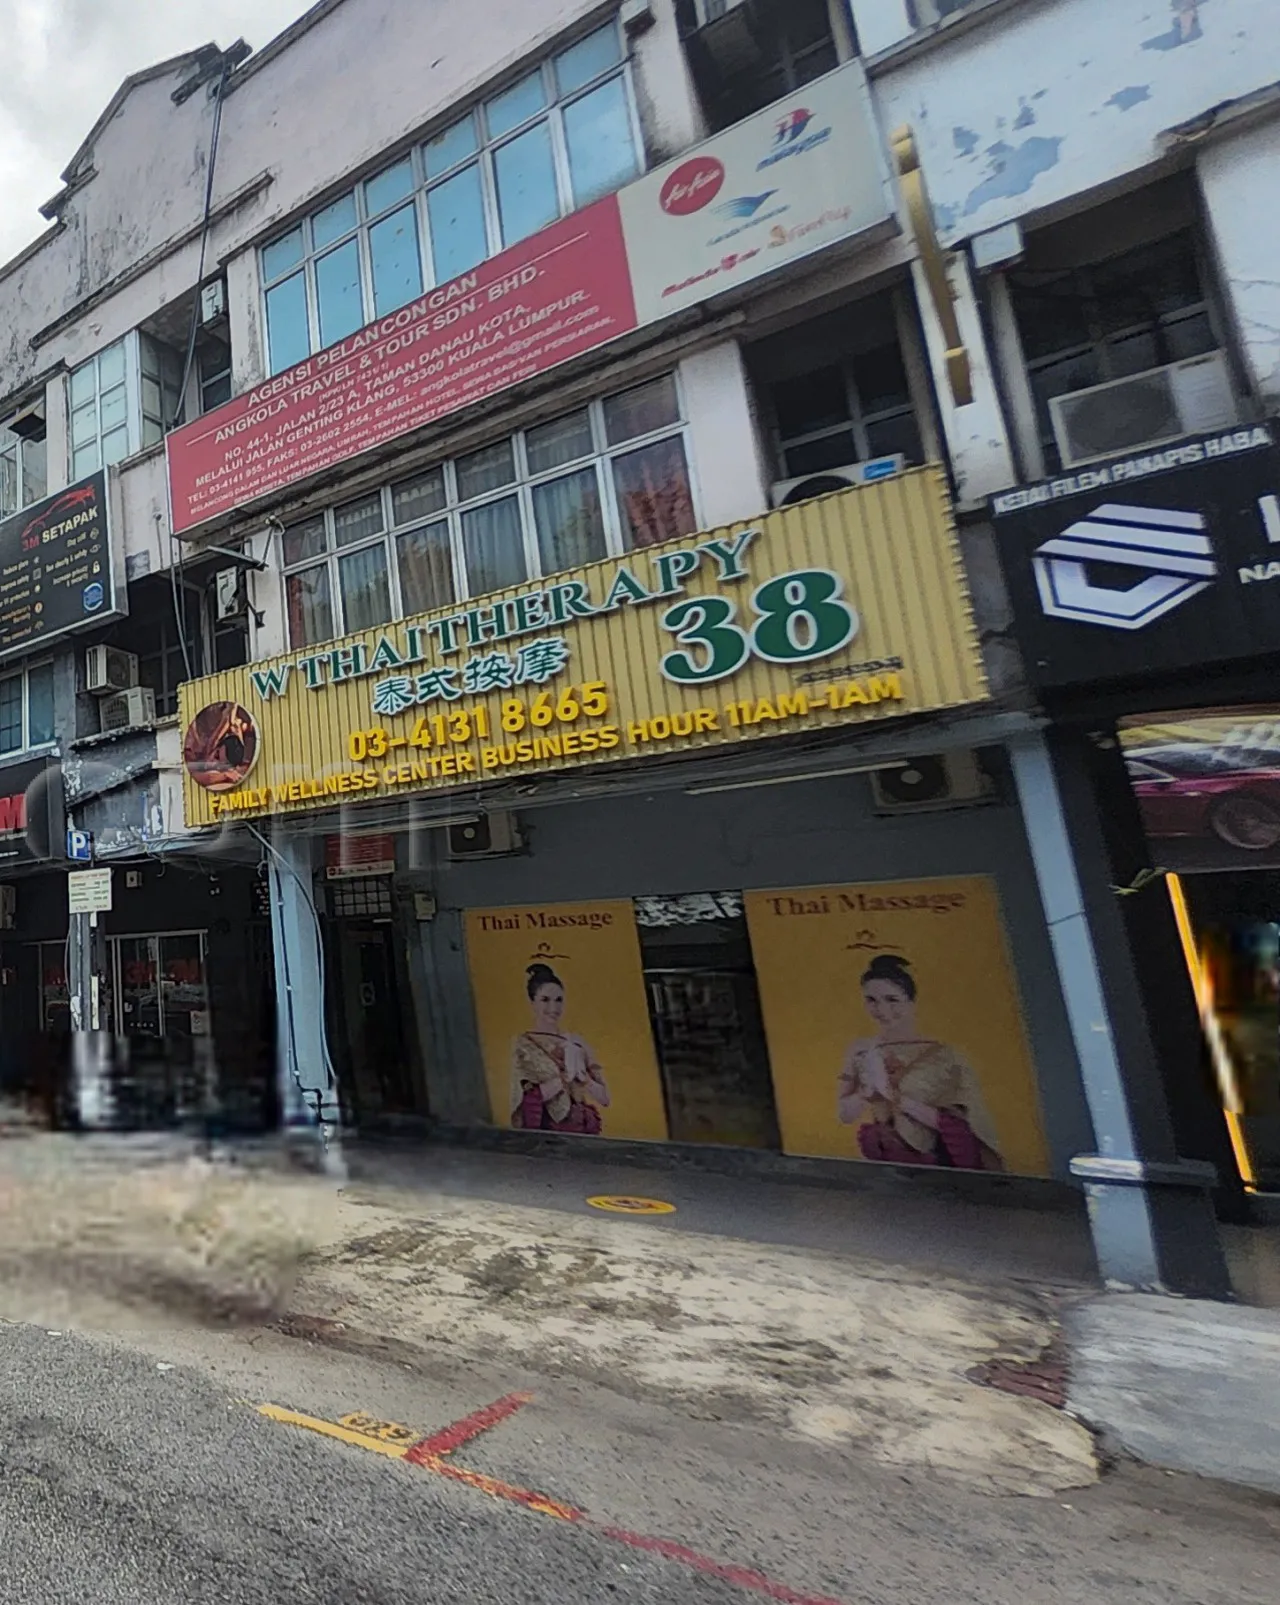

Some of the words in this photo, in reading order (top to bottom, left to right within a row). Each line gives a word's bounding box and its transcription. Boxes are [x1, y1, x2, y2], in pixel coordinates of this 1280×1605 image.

[214, 395, 287, 444] ANGKOLA
[291, 360, 355, 404] TRAVEL
[358, 352, 372, 370] &
[374, 321, 429, 361] TOUR
[432, 293, 483, 331] SDN.
[486, 260, 545, 302] BHD.
[247, 361, 311, 407] AGENSI
[316, 271, 477, 370] PELANCONGAN
[195, 456, 243, 488] MELALUI
[245, 437, 283, 464] JALAN
[286, 407, 343, 444] GENTING
[403, 359, 444, 388] 53300
[447, 328, 504, 365] KUALA
[224, 444, 244, 461] NO.
[275, 408, 315, 436] JALAN
[318, 394, 343, 414] 2/23
[365, 358, 415, 392] TAMAN
[418, 328, 474, 365] DANAU
[42, 505, 98, 543] SETAPAK
[660, 567, 859, 683] 38
[250, 663, 294, 700] W
[372, 636, 571, 715] 泰式按摩
[208, 787, 269, 814] FAMILY
[270, 766, 378, 801] WELLNESS
[382, 750, 475, 786] CENTER
[482, 724, 620, 769] BUSINESS
[627, 708, 720, 744] HOUR
[725, 674, 904, 727] 11AM-1AM
[349, 706, 490, 761] 03-4131
[501, 680, 610, 734] 8665
[72, 832, 86, 857] P
[477, 914, 520, 932] Thai
[525, 910, 613, 931] Massage
[767, 896, 831, 918] Thai
[839, 890, 968, 915] Massage
